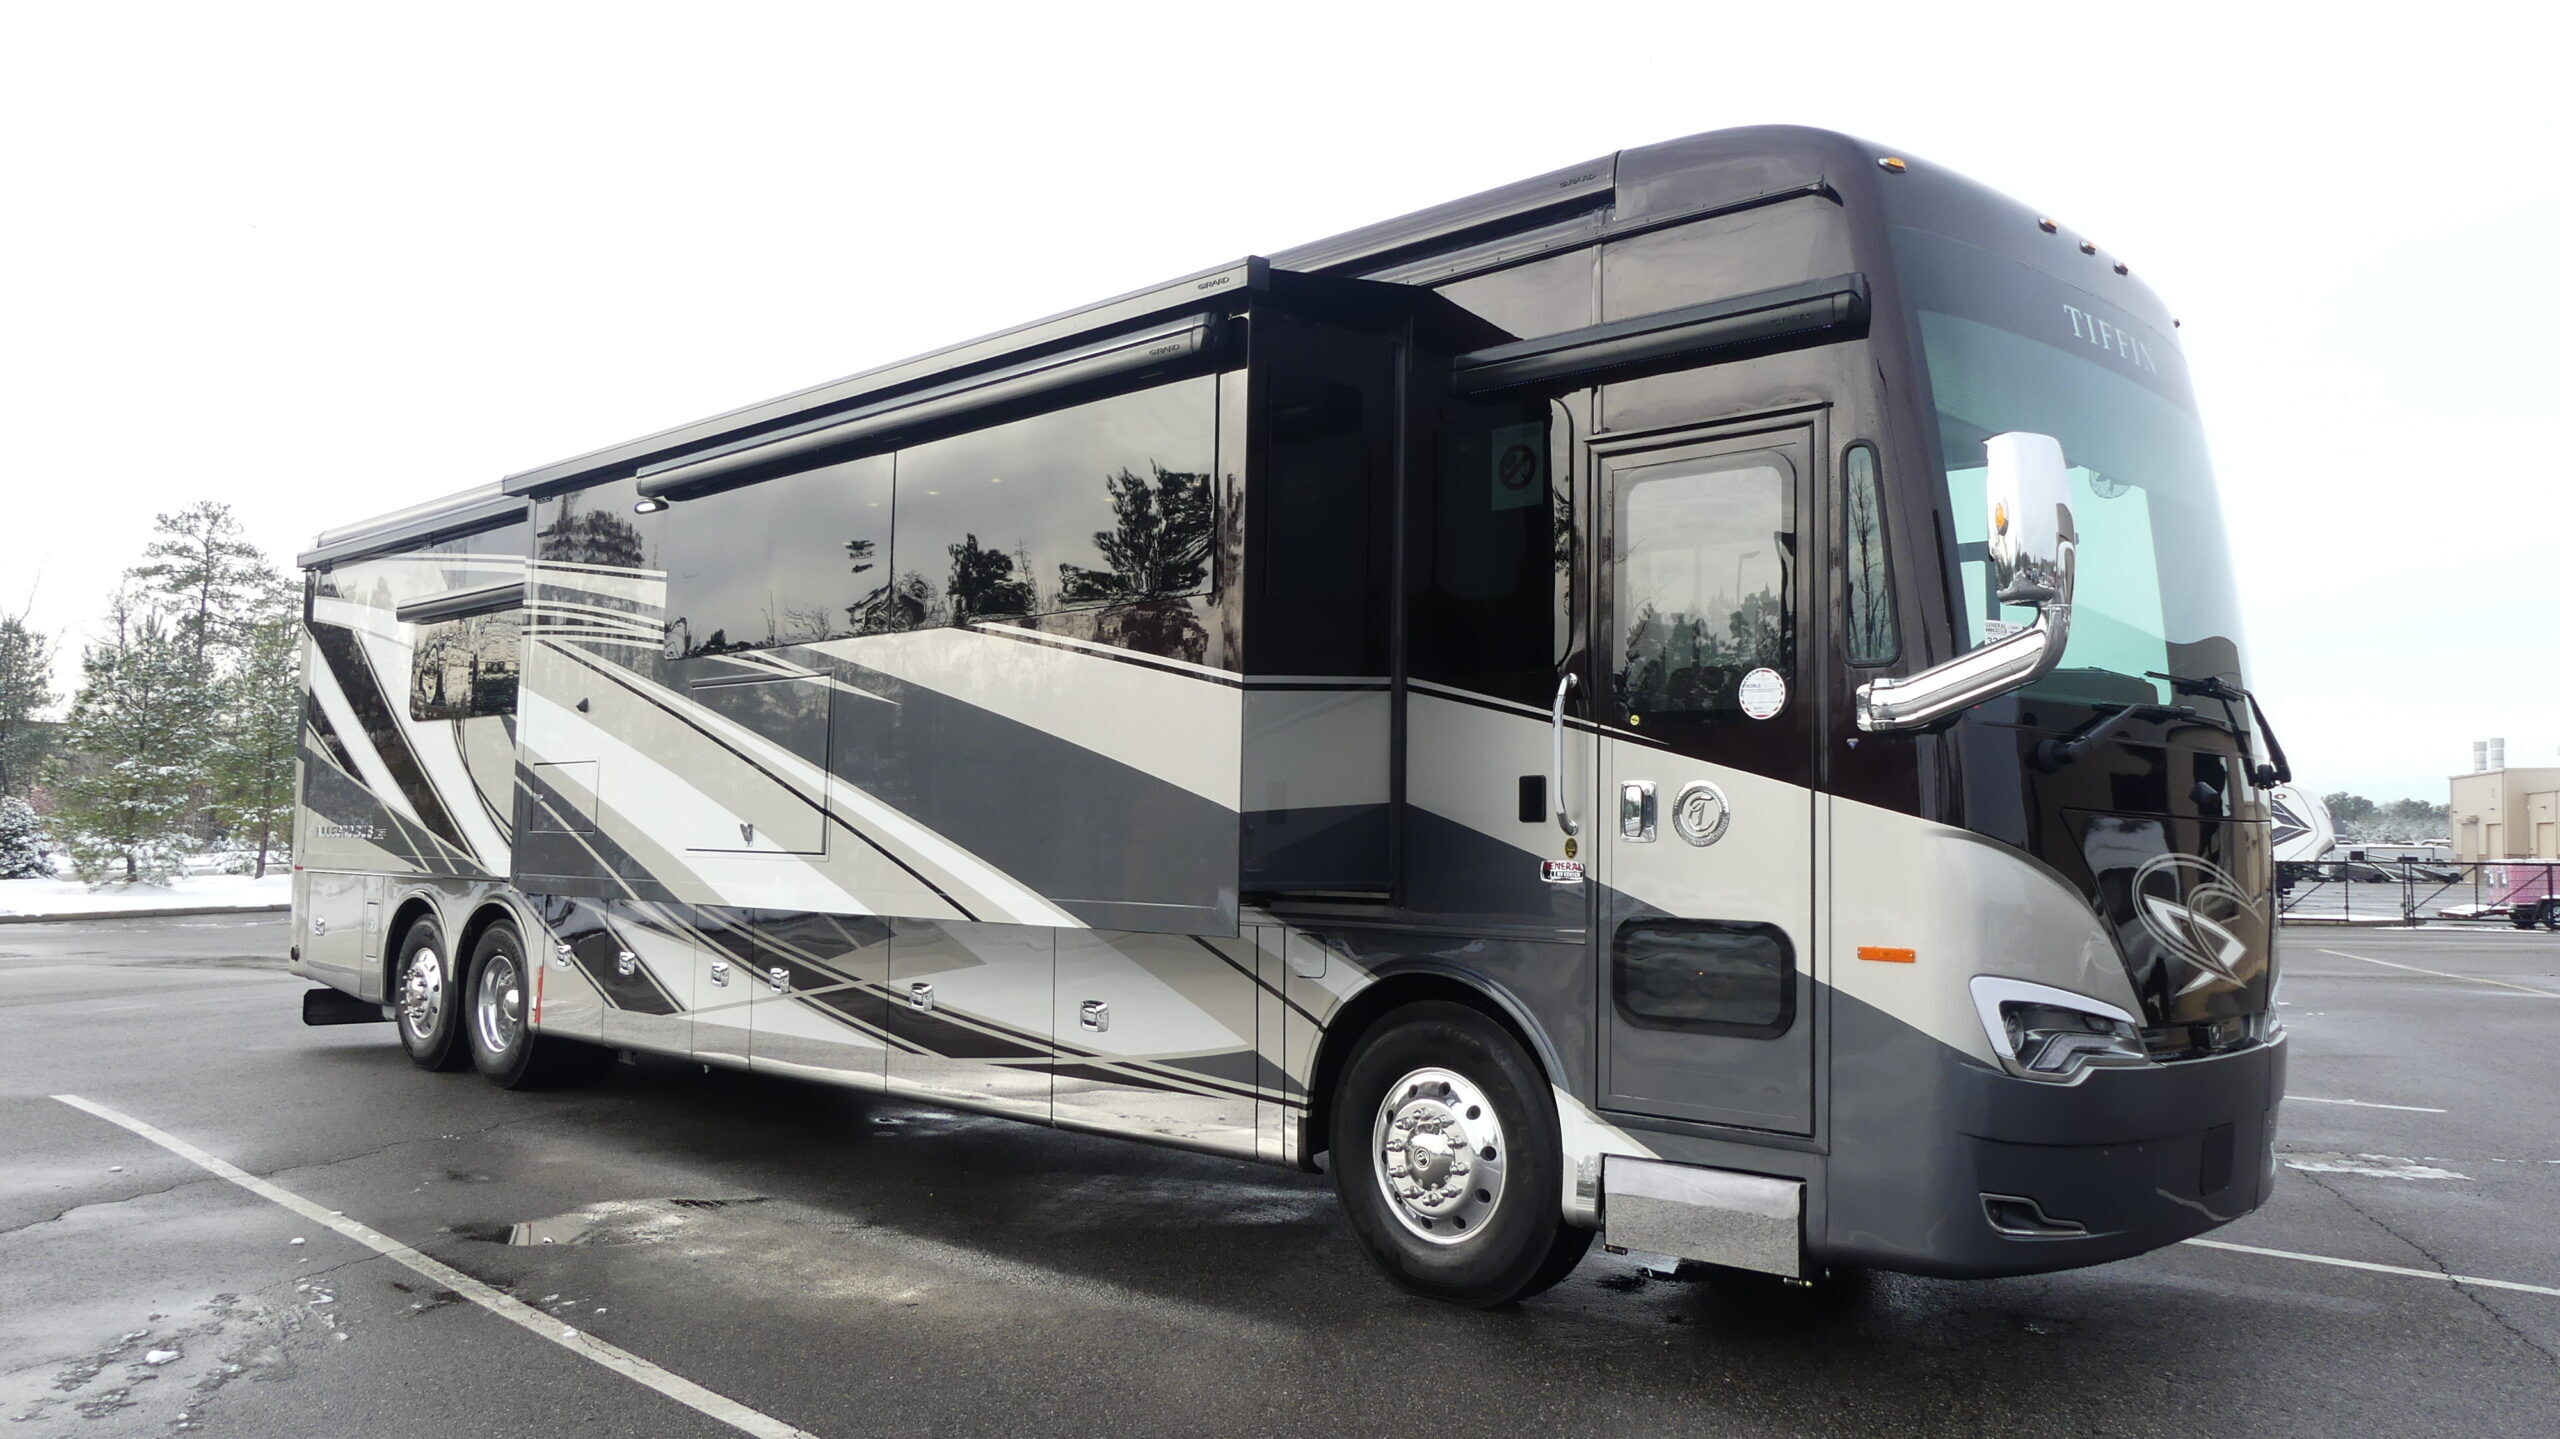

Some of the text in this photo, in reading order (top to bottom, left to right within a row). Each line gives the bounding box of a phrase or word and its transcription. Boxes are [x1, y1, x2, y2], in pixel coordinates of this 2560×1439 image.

[1198, 277, 1230, 290] GIRARD
[2063, 304, 2157, 375] TIFFIN
[1149, 343, 1180, 356] GIRARD
